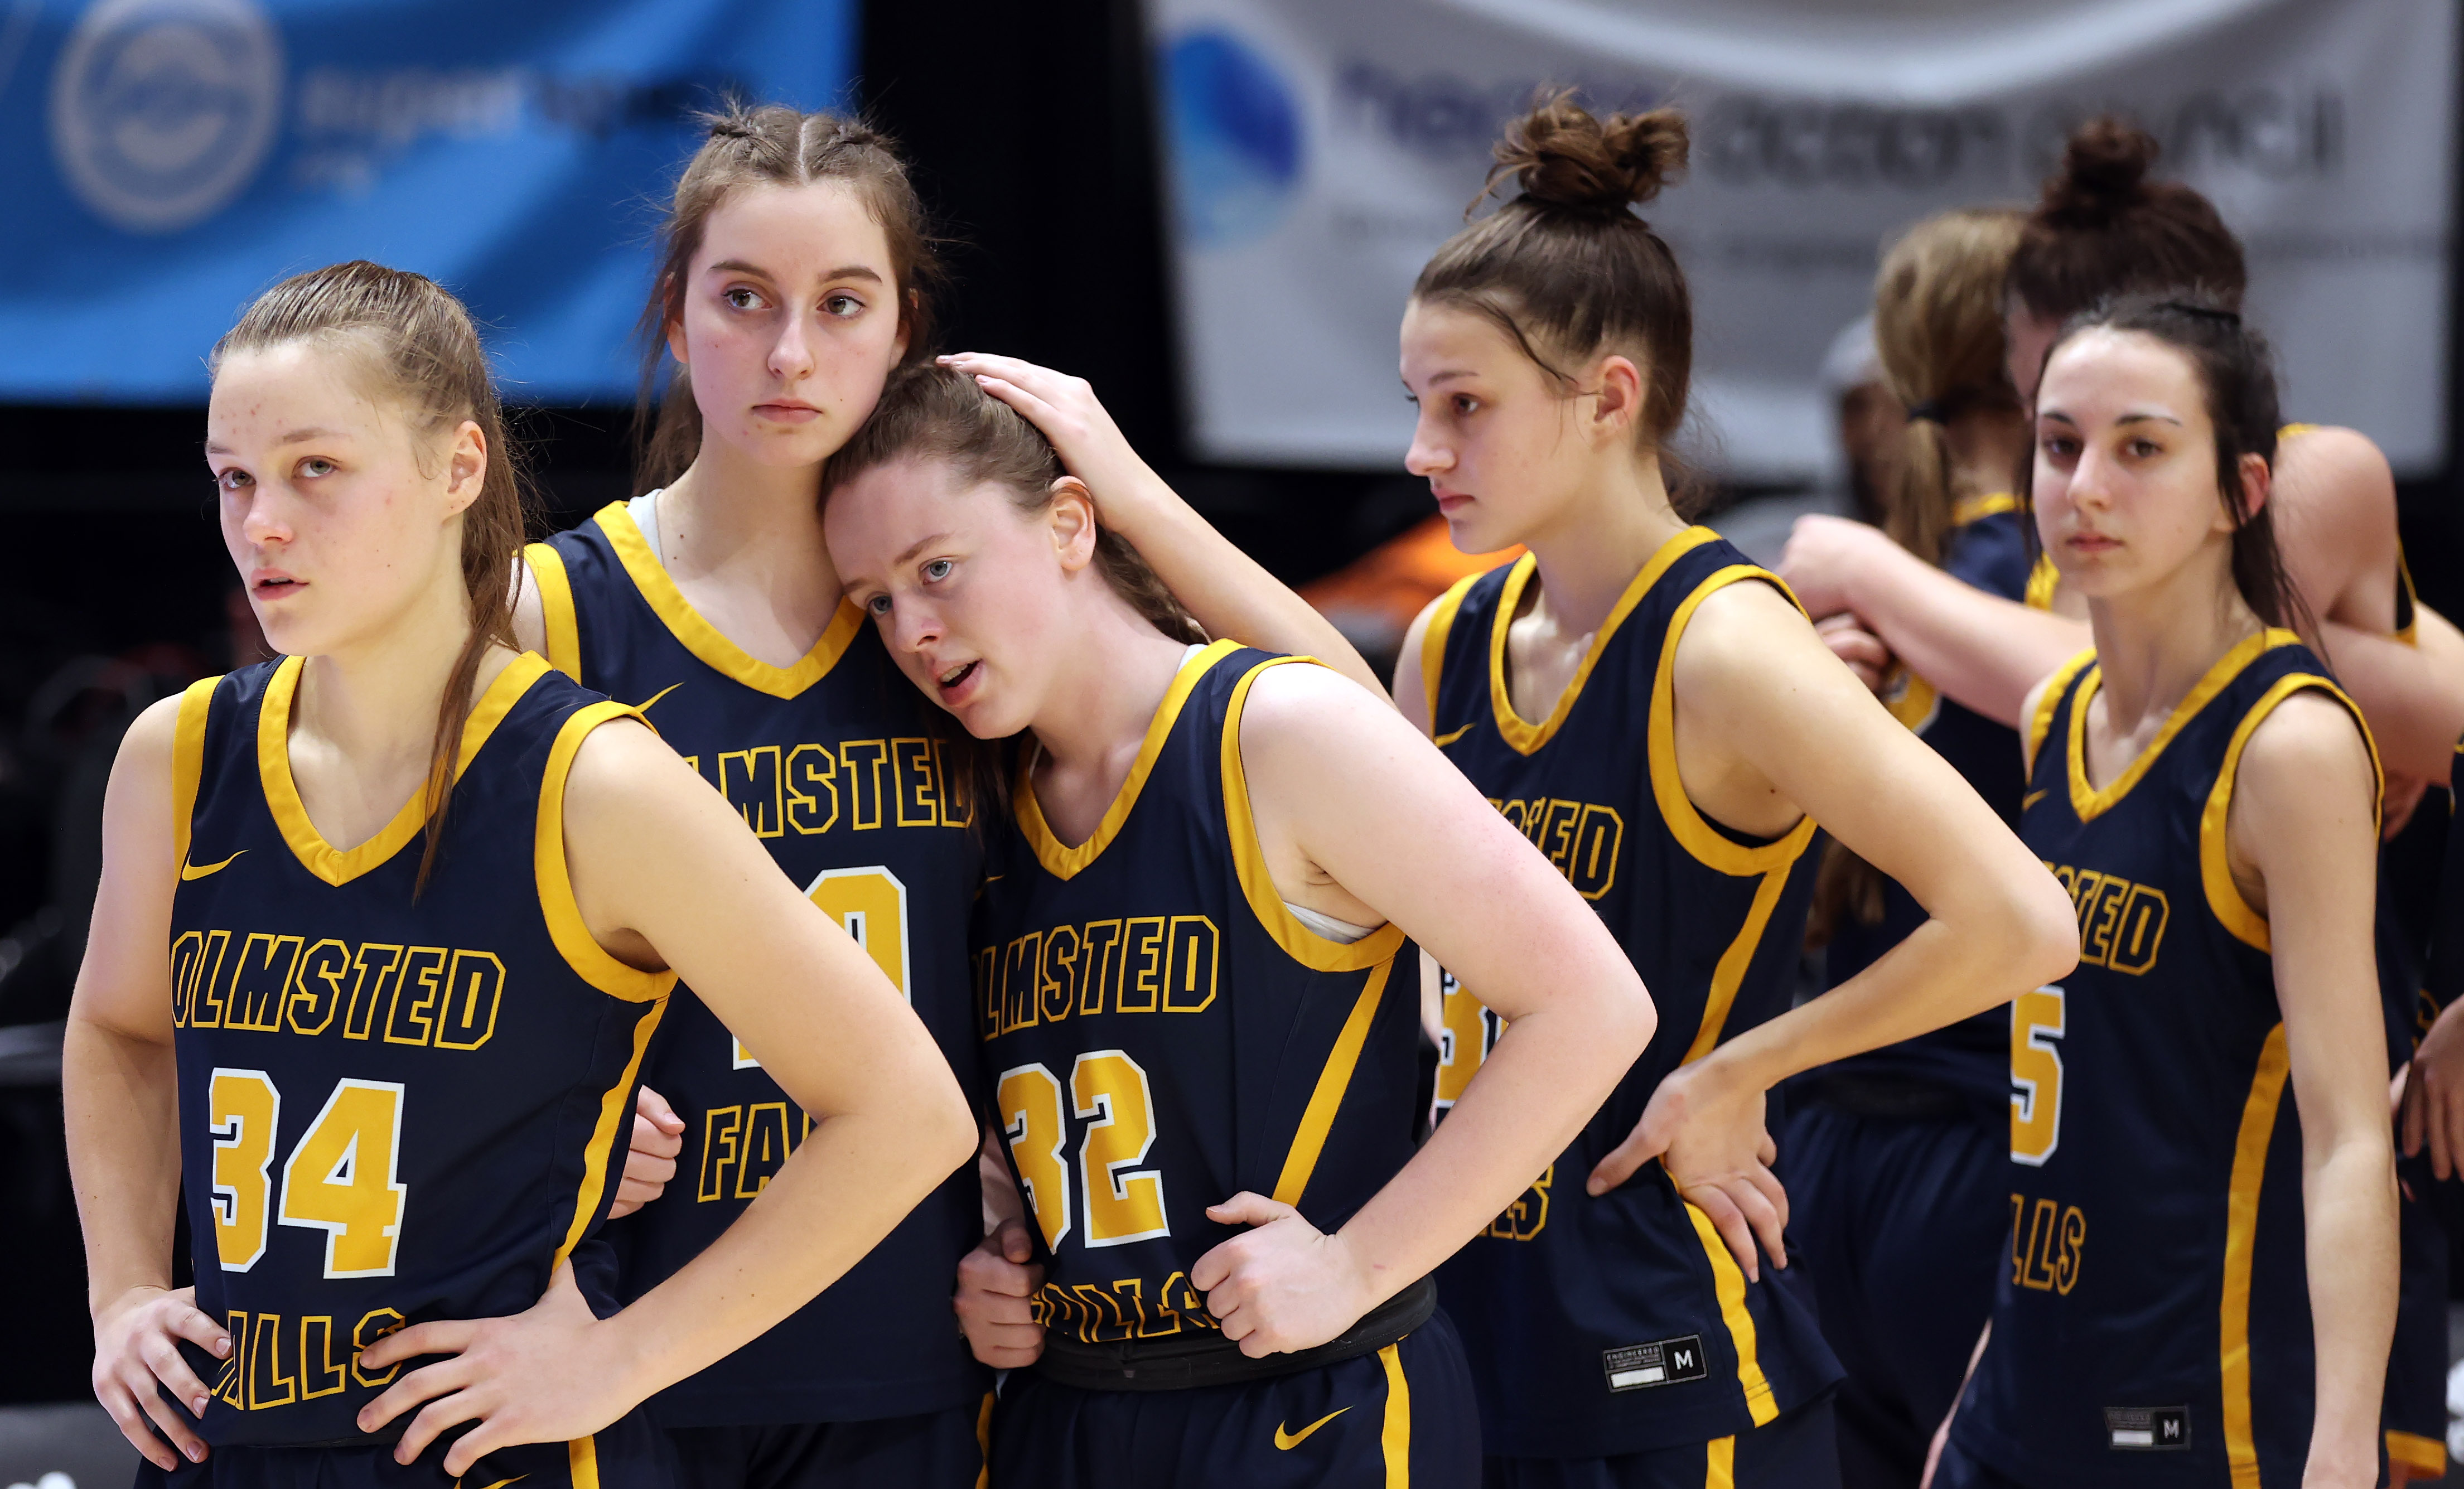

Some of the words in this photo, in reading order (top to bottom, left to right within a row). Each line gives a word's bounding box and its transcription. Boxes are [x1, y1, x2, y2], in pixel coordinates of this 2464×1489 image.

[171, 930, 506, 1051] OLMSTED
[972, 915, 1220, 1042] LMSTED
[208, 1067, 407, 1279] 34
[997, 1049, 1171, 1255] 32
[1674, 1349, 1694, 1371] M
[2163, 1419, 2180, 1439] M
